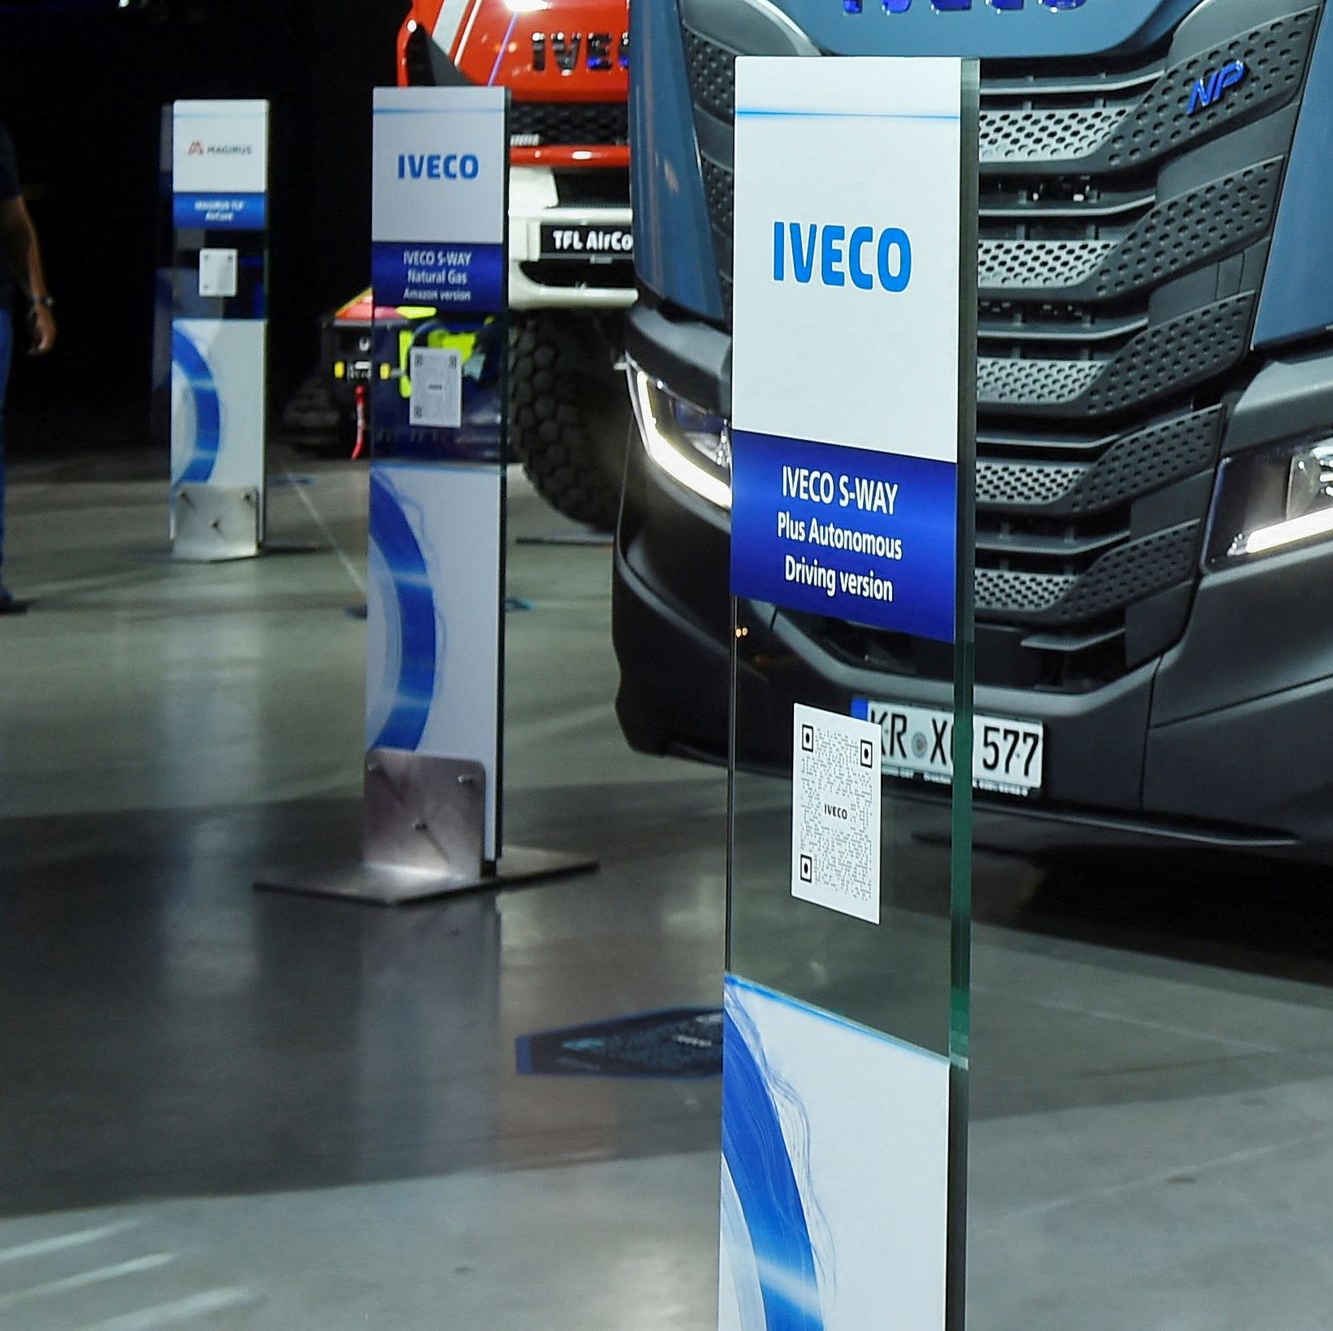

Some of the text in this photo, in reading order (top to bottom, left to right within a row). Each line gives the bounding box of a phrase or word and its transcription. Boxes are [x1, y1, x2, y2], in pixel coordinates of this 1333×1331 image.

[397, 154, 480, 181] IVECO
[553, 230, 583, 250] TFL
[403, 250, 472, 267] IVECO S-WAY
[773, 221, 912, 293] IVECO
[407, 269, 467, 285] Natural Gas
[403, 287, 471, 301] Amazon version
[782, 465, 898, 515] IVECO S-WAY
[778, 511, 902, 560] Plus Autonomous
[785, 554, 893, 602] Driving version
[930, 718, 955, 765] X
[982, 725, 1040, 777] 577
[824, 803, 848, 820] IVECO
